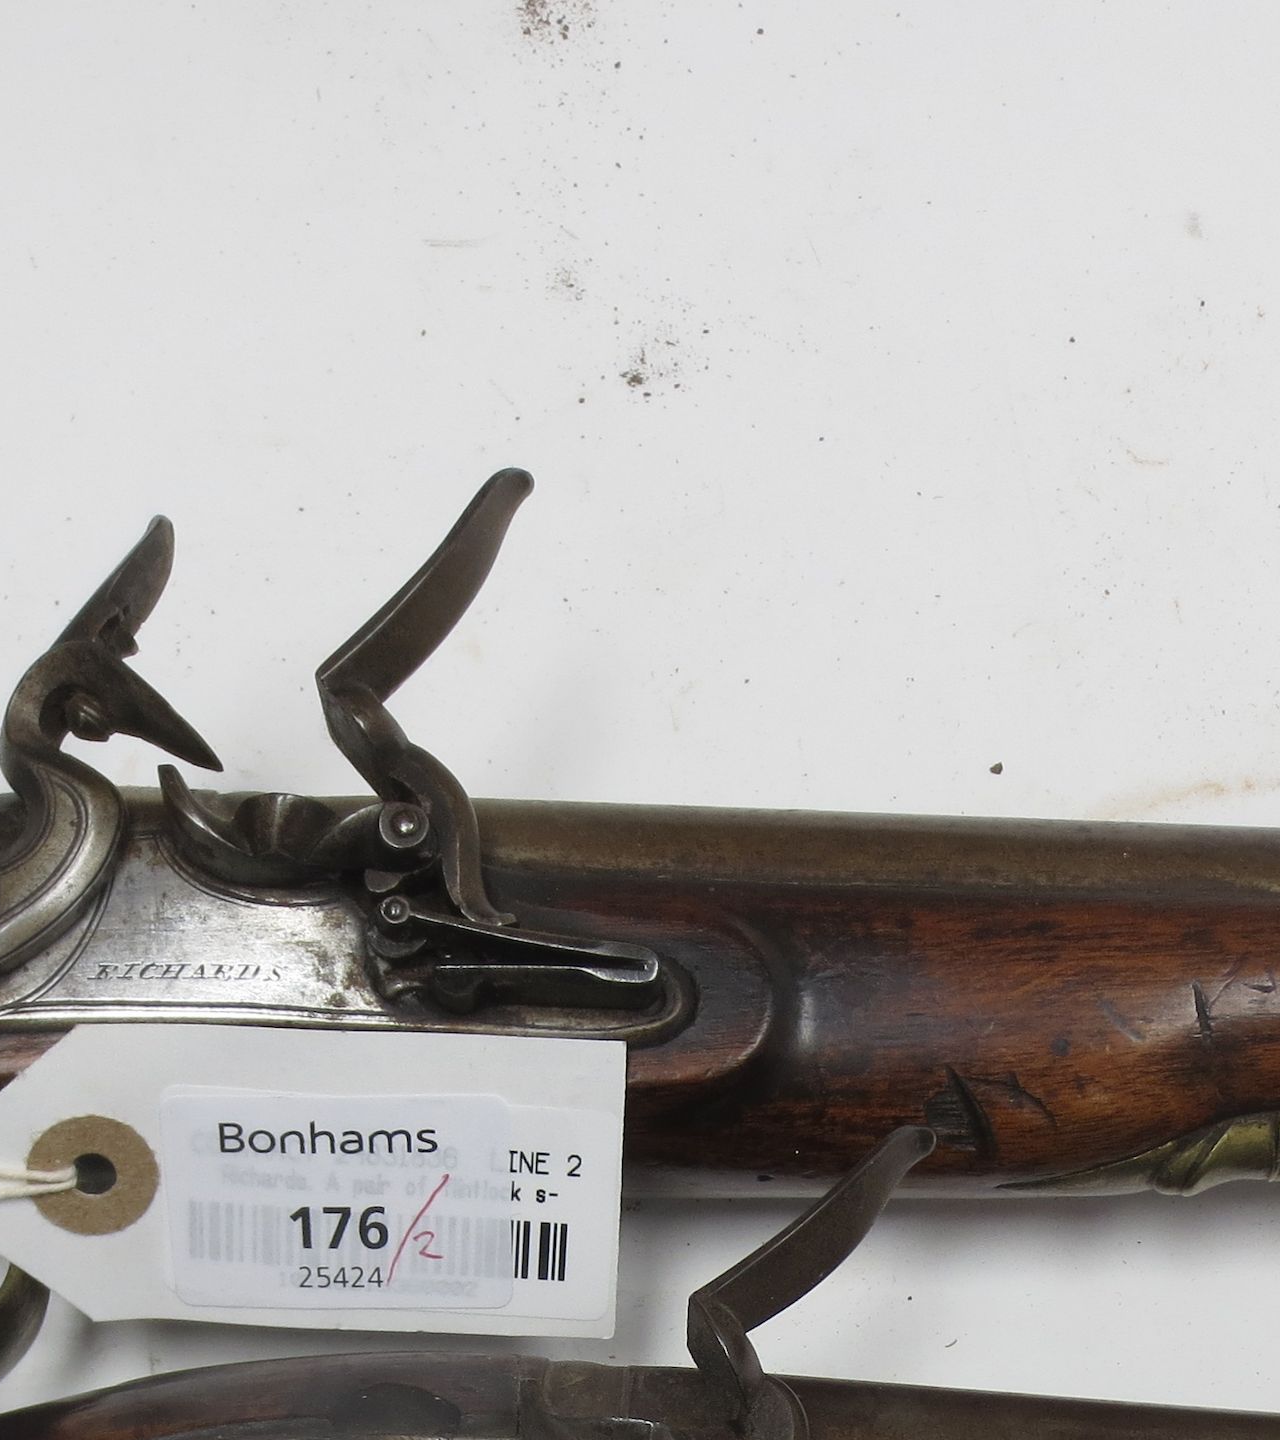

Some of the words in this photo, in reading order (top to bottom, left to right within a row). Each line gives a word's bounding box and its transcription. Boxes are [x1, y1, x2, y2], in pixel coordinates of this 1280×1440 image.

[218, 1121, 438, 1154] Bonhams
[566, 1154, 582, 1178] 2
[298, 1265, 385, 1289] 25424
